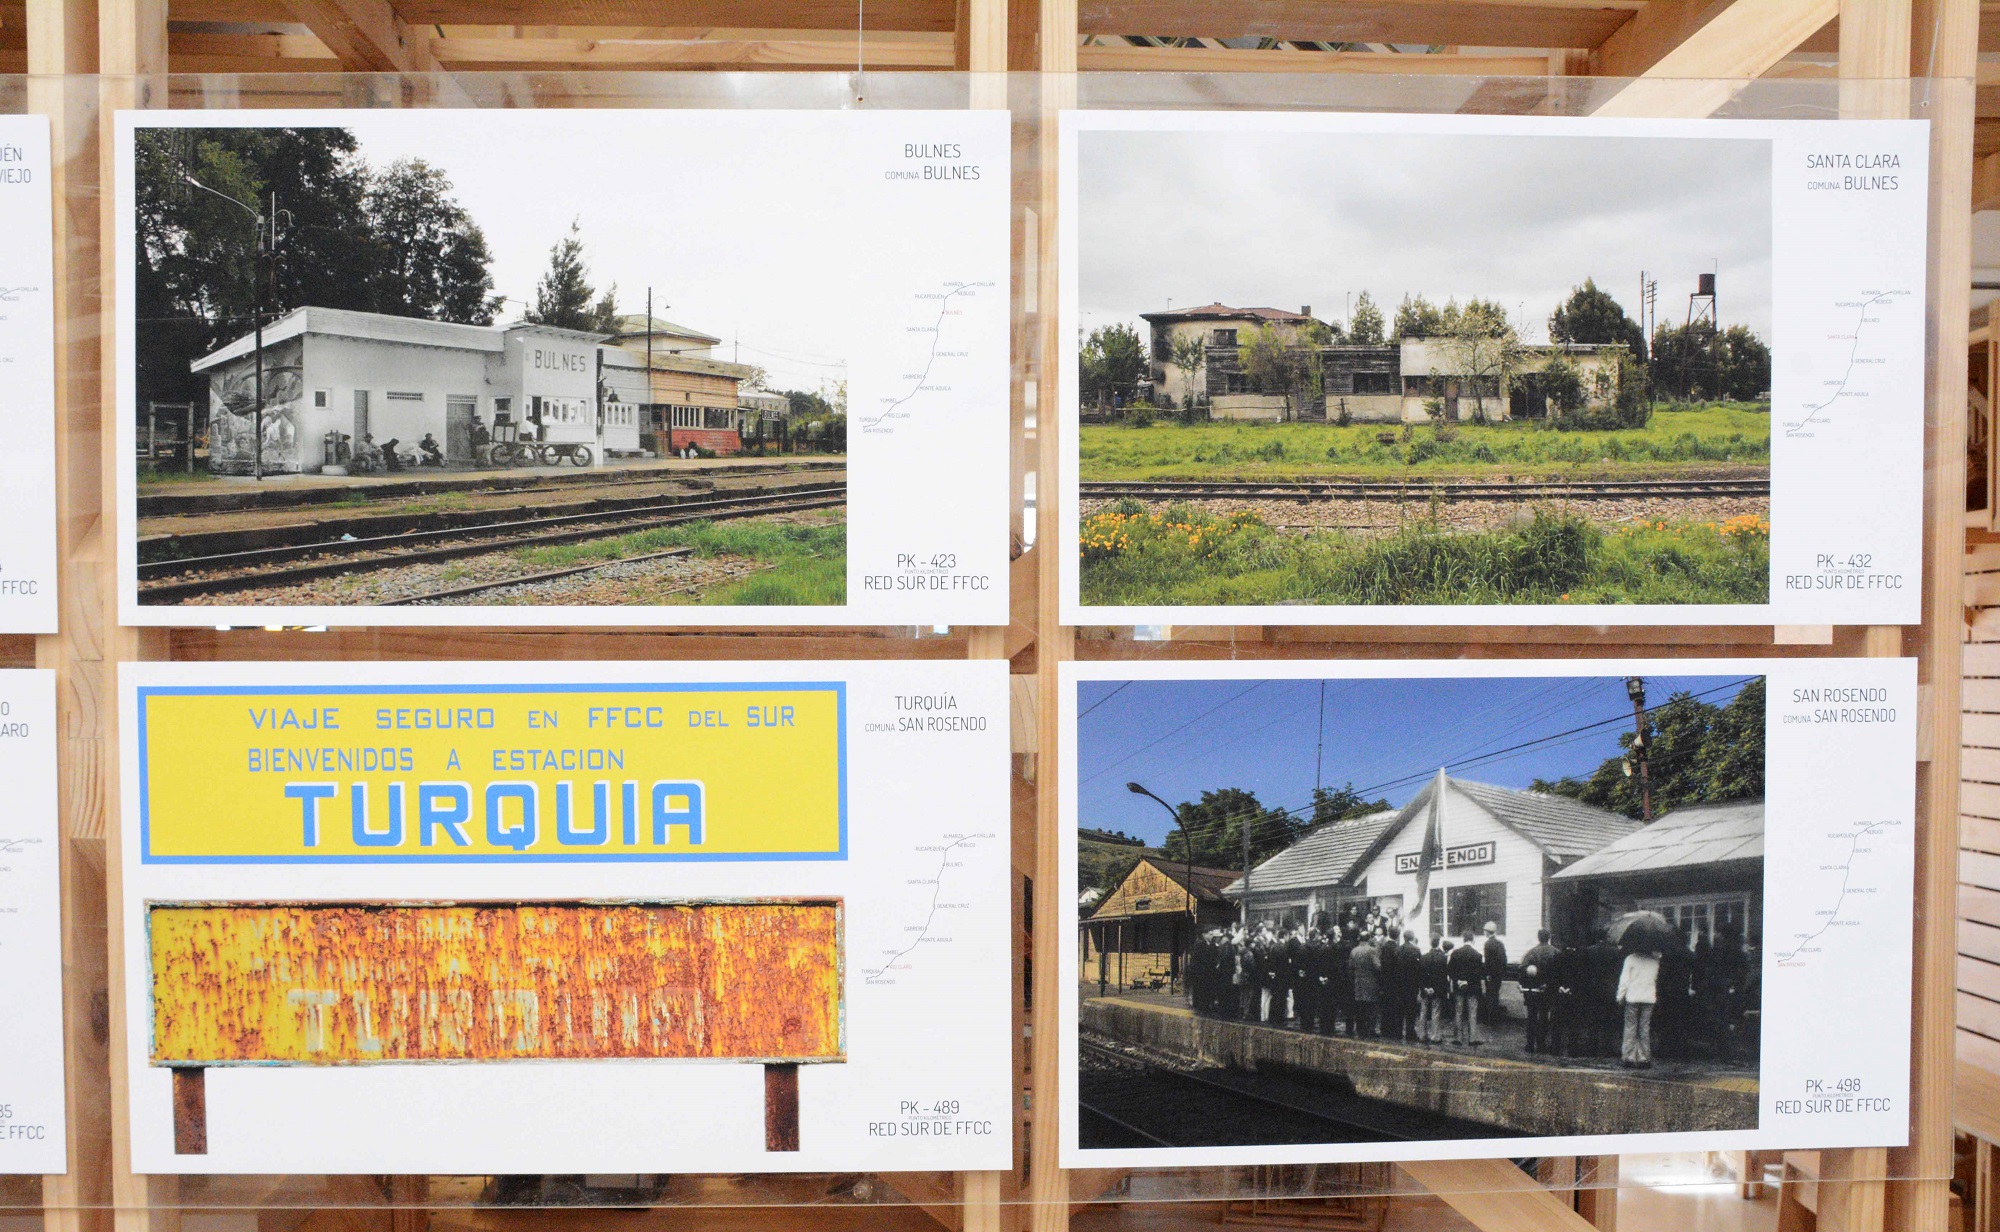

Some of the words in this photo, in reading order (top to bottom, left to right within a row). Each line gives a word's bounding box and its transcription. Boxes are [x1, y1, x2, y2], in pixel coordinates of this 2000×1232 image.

[905, 144, 961, 158] BULNES
[1807, 154, 1851, 168] SANTA
[1856, 154, 1900, 168] CLARA
[885, 171, 920, 180] COMUNA
[924, 166, 980, 180] BULNES
[1845, 176, 1898, 190] BULNES
[535, 350, 586, 372] BULNES
[897, 554, 916, 568] PK
[930, 554, 956, 568] 423
[1817, 554, 1834, 567] PK
[1848, 554, 1872, 567] 432
[2, 580, 38, 594] FFCC
[864, 576, 892, 590] RED
[897, 576, 926, 590] SUR
[930, 576, 948, 590] DE
[954, 576, 989, 590] FFCC
[1786, 576, 1812, 589] RED
[1816, 575, 1842, 589] SUR
[1847, 575, 1864, 588] DE
[1868, 575, 1902, 588] FFCC
[895, 692, 957, 711] TURQUÍA
[1793, 689, 1819, 703] SAN
[1824, 688, 1887, 702] ROSENDO
[248, 708, 339, 729] VIAJE
[376, 708, 494, 729] SEGURO
[528, 710, 558, 728] EN
[588, 707, 663, 728] FFCC
[688, 710, 729, 727] DEL
[747, 706, 794, 727] SUR
[1814, 709, 1837, 723] SAN
[1841, 708, 1896, 723] ROSENDO
[865, 724, 895, 732] COMUNA
[899, 717, 923, 731] SAN
[928, 717, 986, 731] ROSENDO
[248, 748, 413, 772] BIENVENIDOS
[446, 748, 461, 771] A
[493, 749, 624, 771] ESTACION
[284, 780, 706, 850] TURQUIA
[1806, 1080, 1823, 1092] PK
[1836, 1079, 1861, 1092] 498
[900, 1101, 919, 1114] PK
[934, 1100, 960, 1114] 489
[1776, 1100, 1801, 1114] RED
[1806, 1100, 1831, 1113] SUR
[1836, 1099, 1853, 1112] DE
[1857, 1098, 1890, 1112] FFCC
[10, 1126, 44, 1139] FFCC
[869, 1122, 896, 1136] RED
[901, 1122, 929, 1136] SUR
[933, 1122, 951, 1135] DE
[956, 1121, 991, 1135] FFCC
